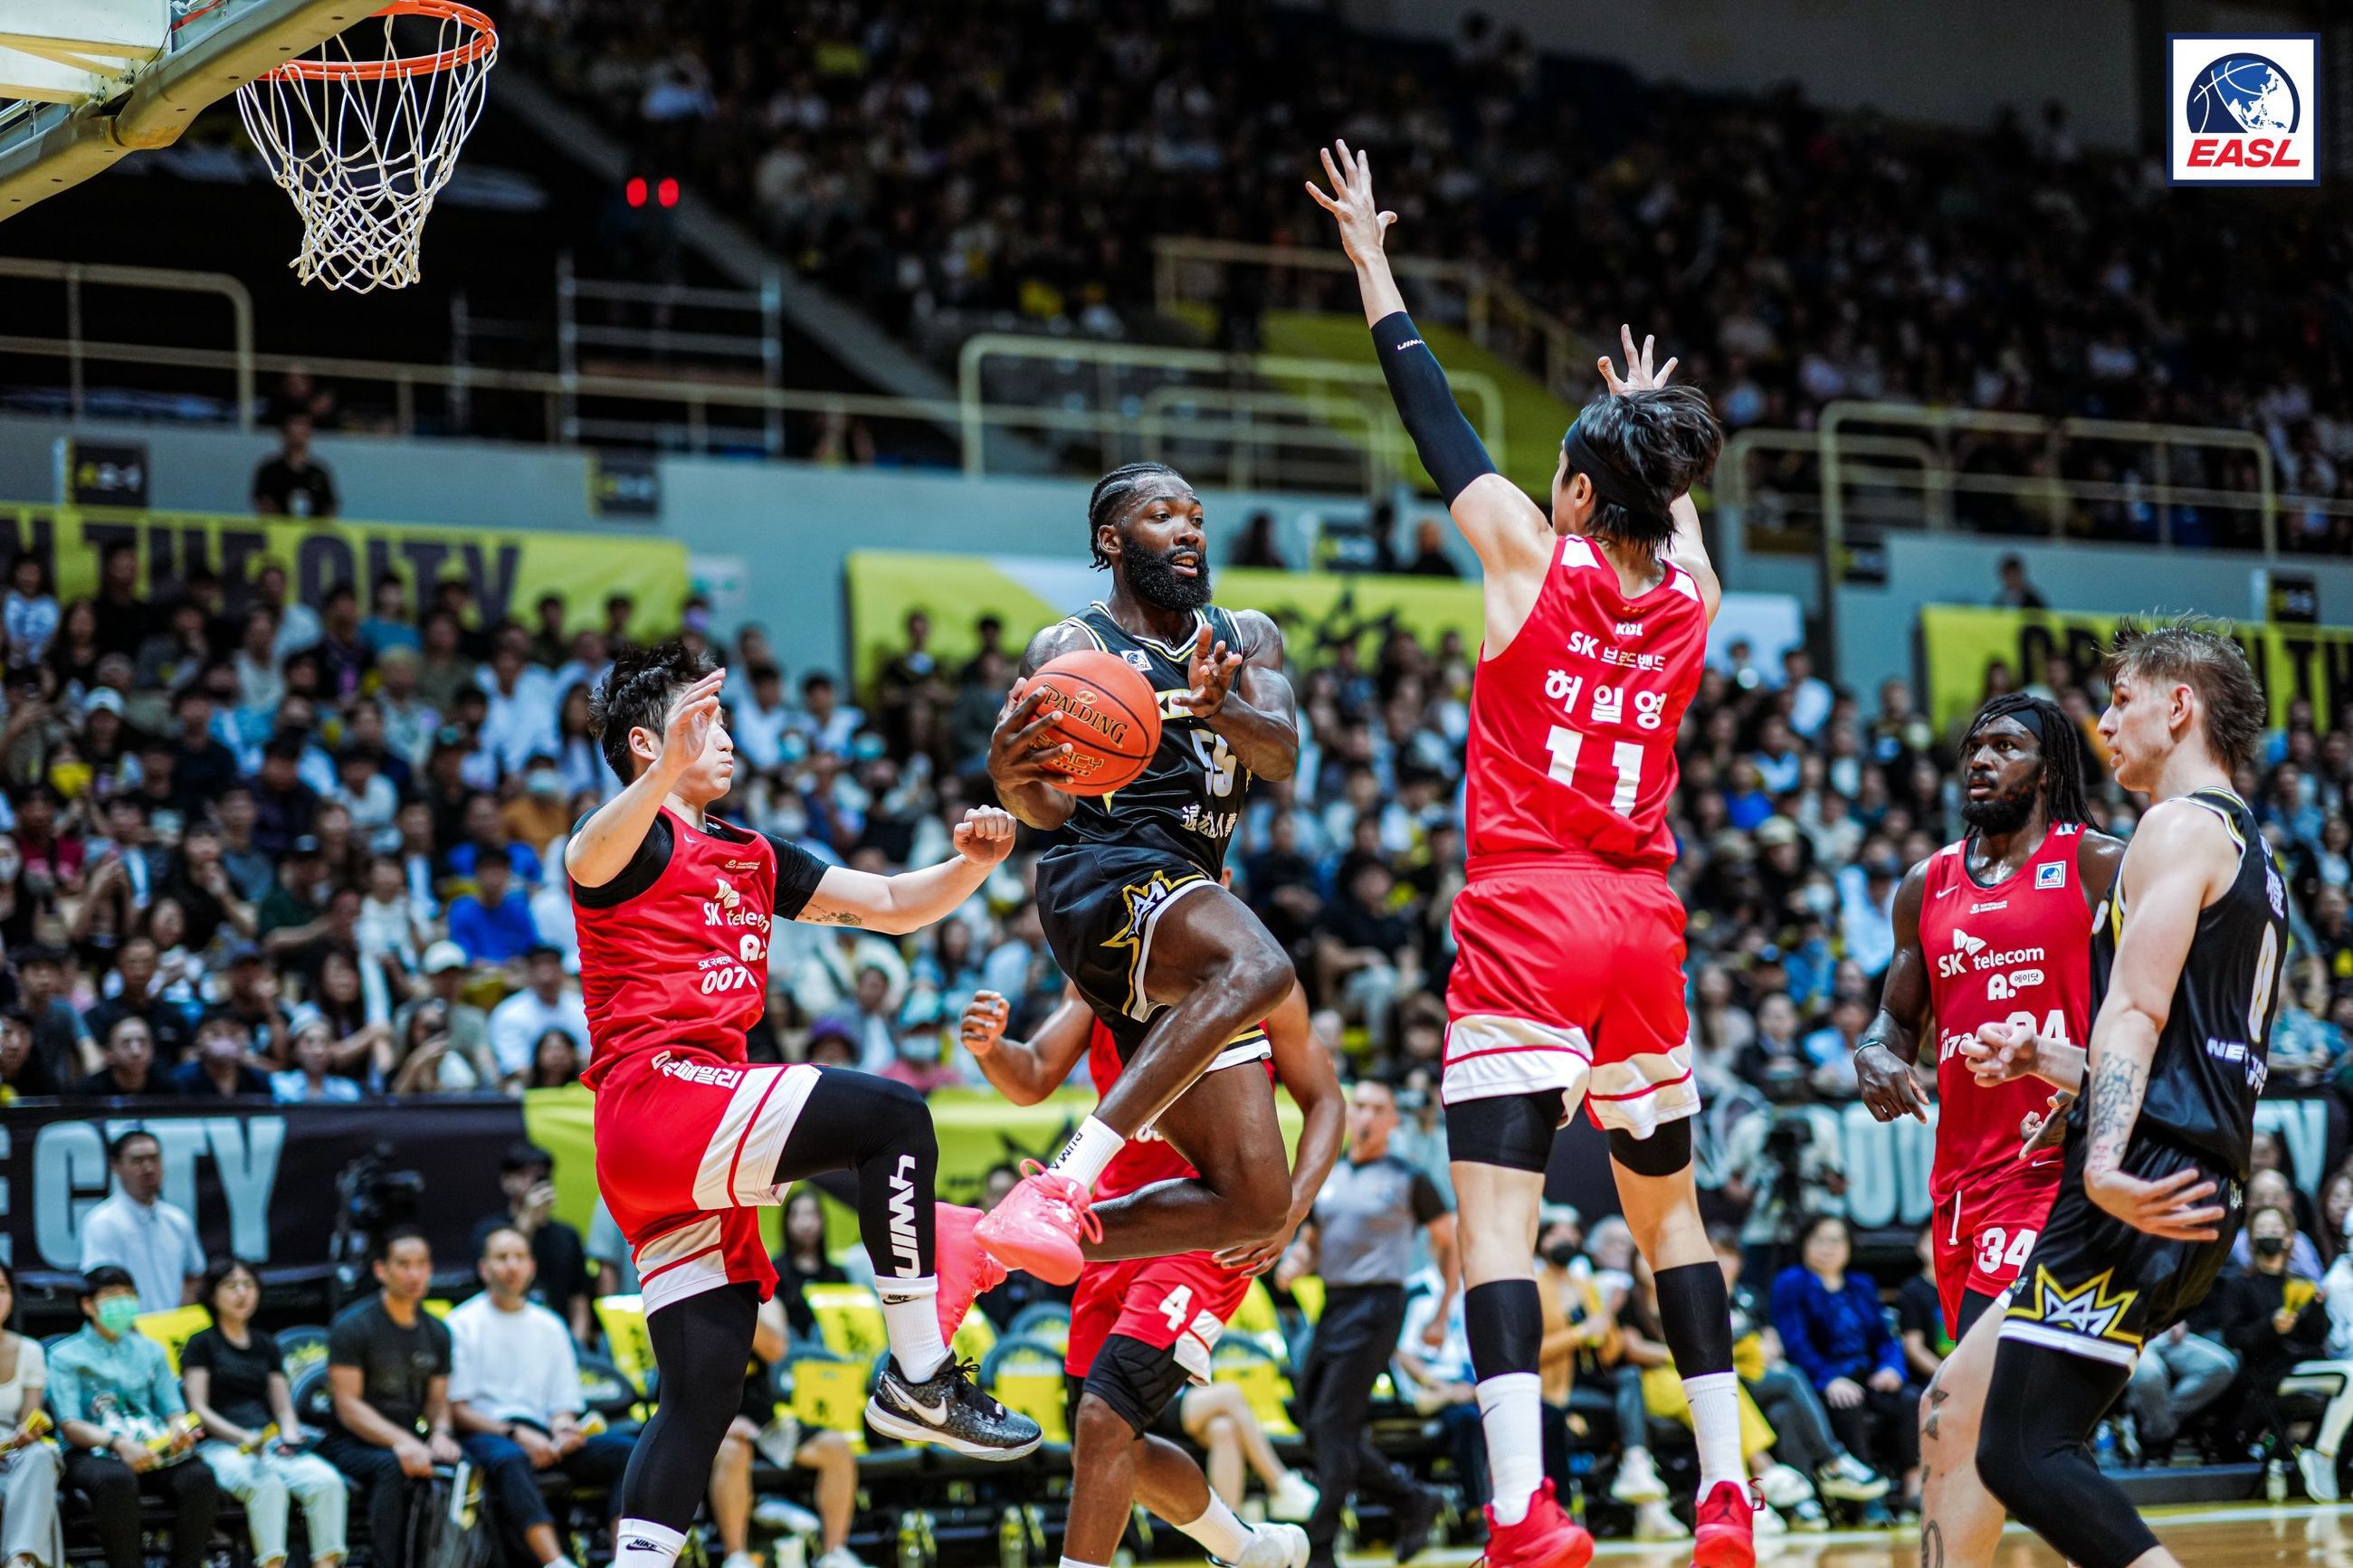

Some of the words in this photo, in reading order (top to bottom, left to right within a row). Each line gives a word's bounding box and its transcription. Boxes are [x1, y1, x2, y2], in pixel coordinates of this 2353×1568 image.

[1615, 622, 1643, 636] KBL
[1567, 631, 1600, 659] SK
[1600, 646, 1666, 672] 브로드밴드
[1042, 682, 1129, 749] PALDING
[1545, 668, 1667, 730] 허일영
[1545, 725, 1643, 819] 11
[703, 902, 723, 927] SK
[1938, 952, 1967, 978] SK
[1973, 947, 2044, 970] telecom
[2015, 973, 2039, 983] 에이닷
[32, 1116, 288, 1271] CTY
[1978, 1227, 2038, 1278] 34
[887, 1294, 911, 1302] NIKE
[1158, 1284, 1194, 1332] 4
[633, 1538, 658, 1550] NIKE
